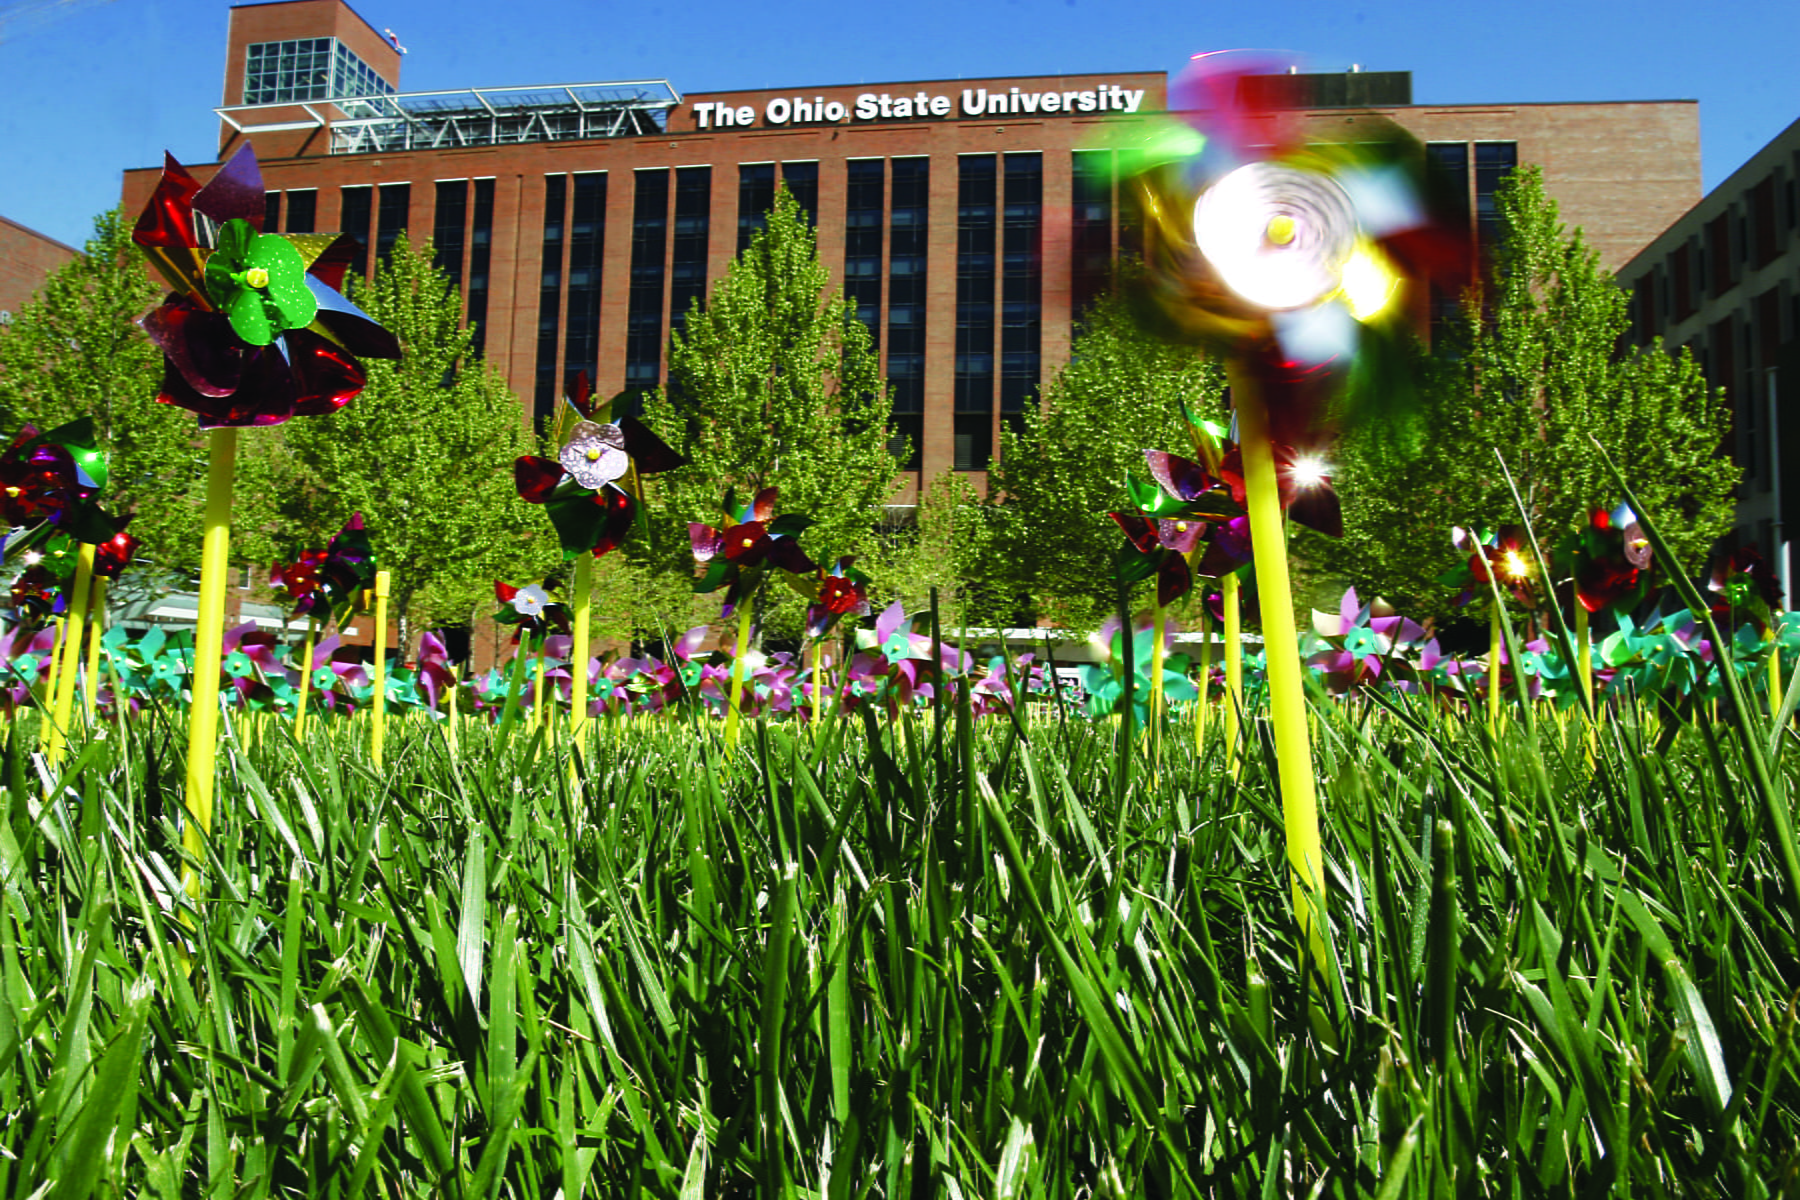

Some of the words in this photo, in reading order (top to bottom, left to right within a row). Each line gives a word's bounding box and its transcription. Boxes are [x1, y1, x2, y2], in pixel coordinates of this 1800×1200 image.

[693, 101, 756, 128] The
[765, 97, 845, 124] Ohio
[855, 92, 951, 120] State
[962, 84, 1145, 115] University
